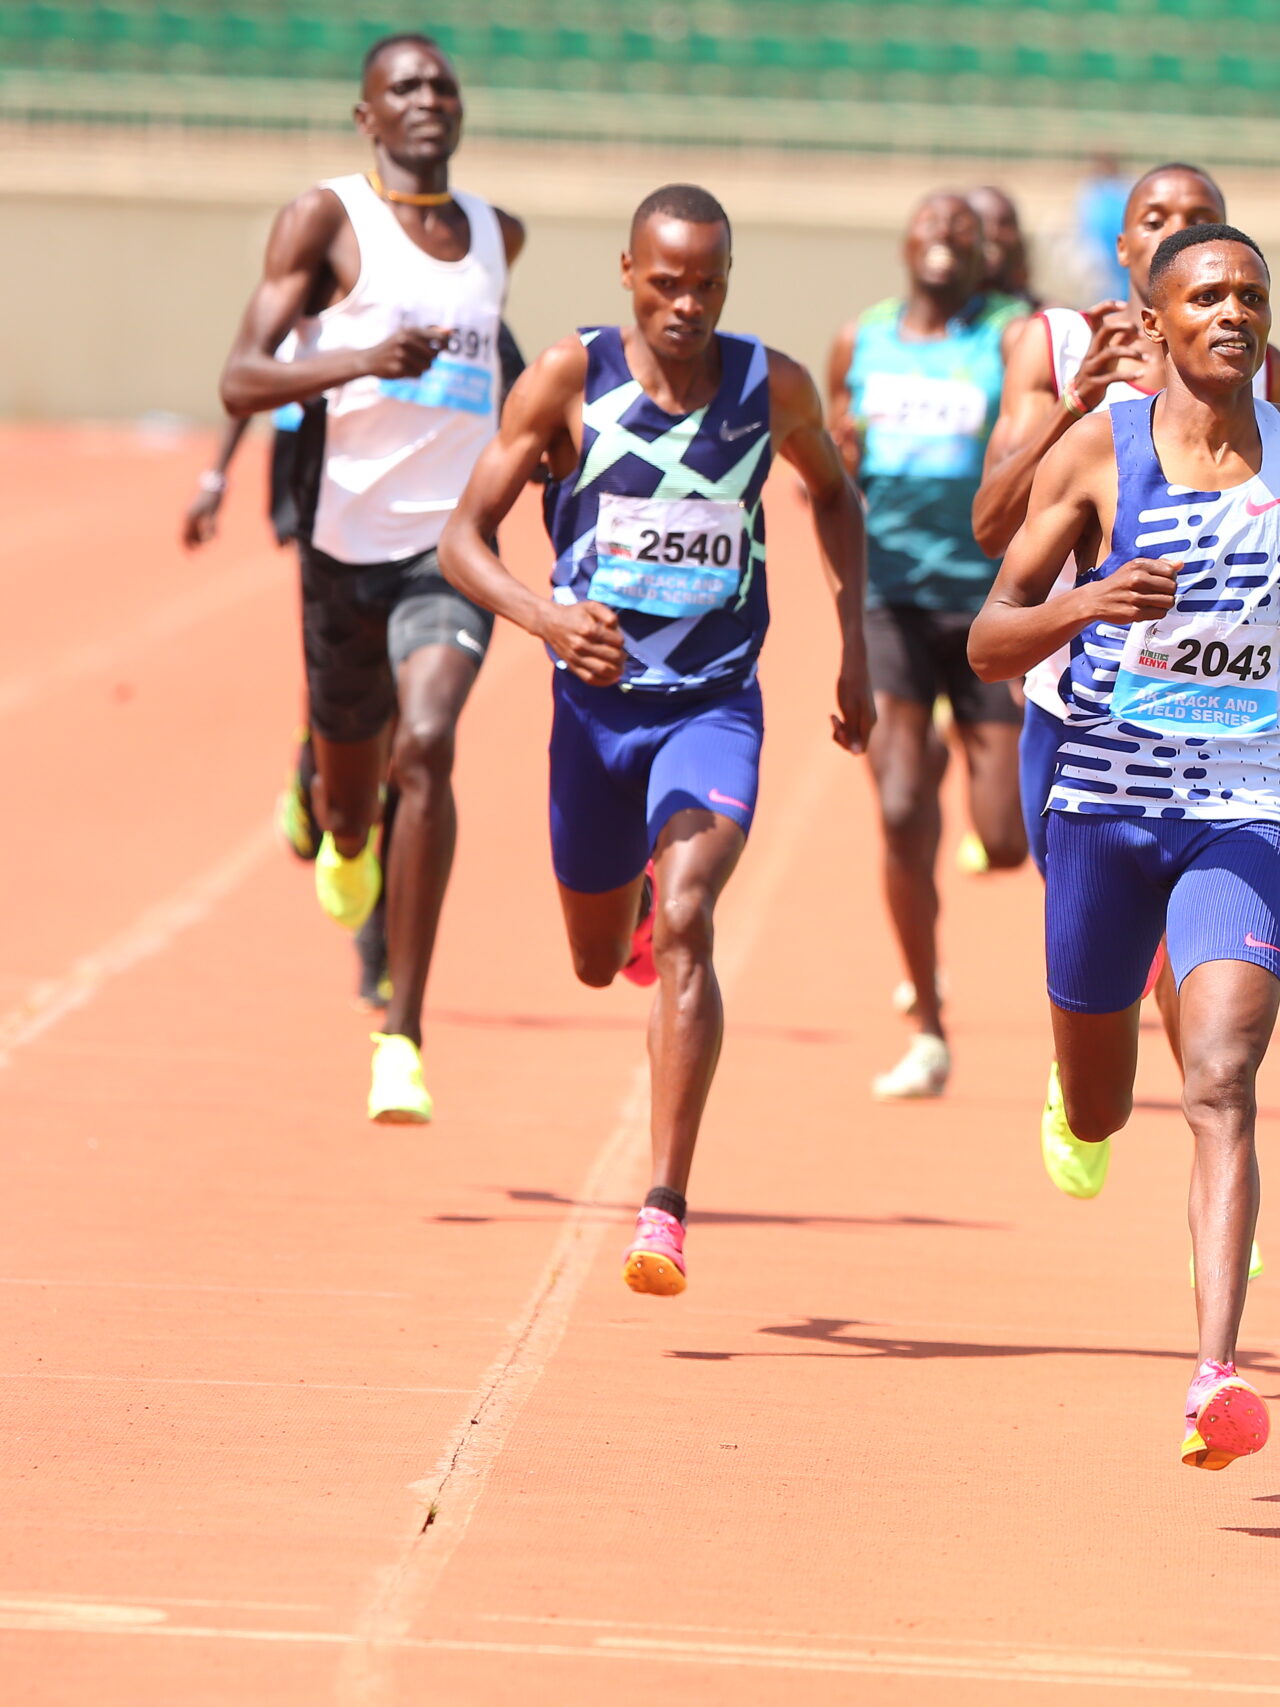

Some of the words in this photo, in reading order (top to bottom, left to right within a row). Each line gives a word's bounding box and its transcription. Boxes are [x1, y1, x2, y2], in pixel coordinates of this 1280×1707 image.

[425, 324, 492, 362] 691
[637, 530, 732, 566] 2540
[1138, 656, 1168, 670] KENYA
[1171, 638, 1272, 681] 2043
[1165, 691, 1221, 708] TRACK
[1224, 698, 1258, 713] AND
[1191, 708, 1251, 726] SERIES
